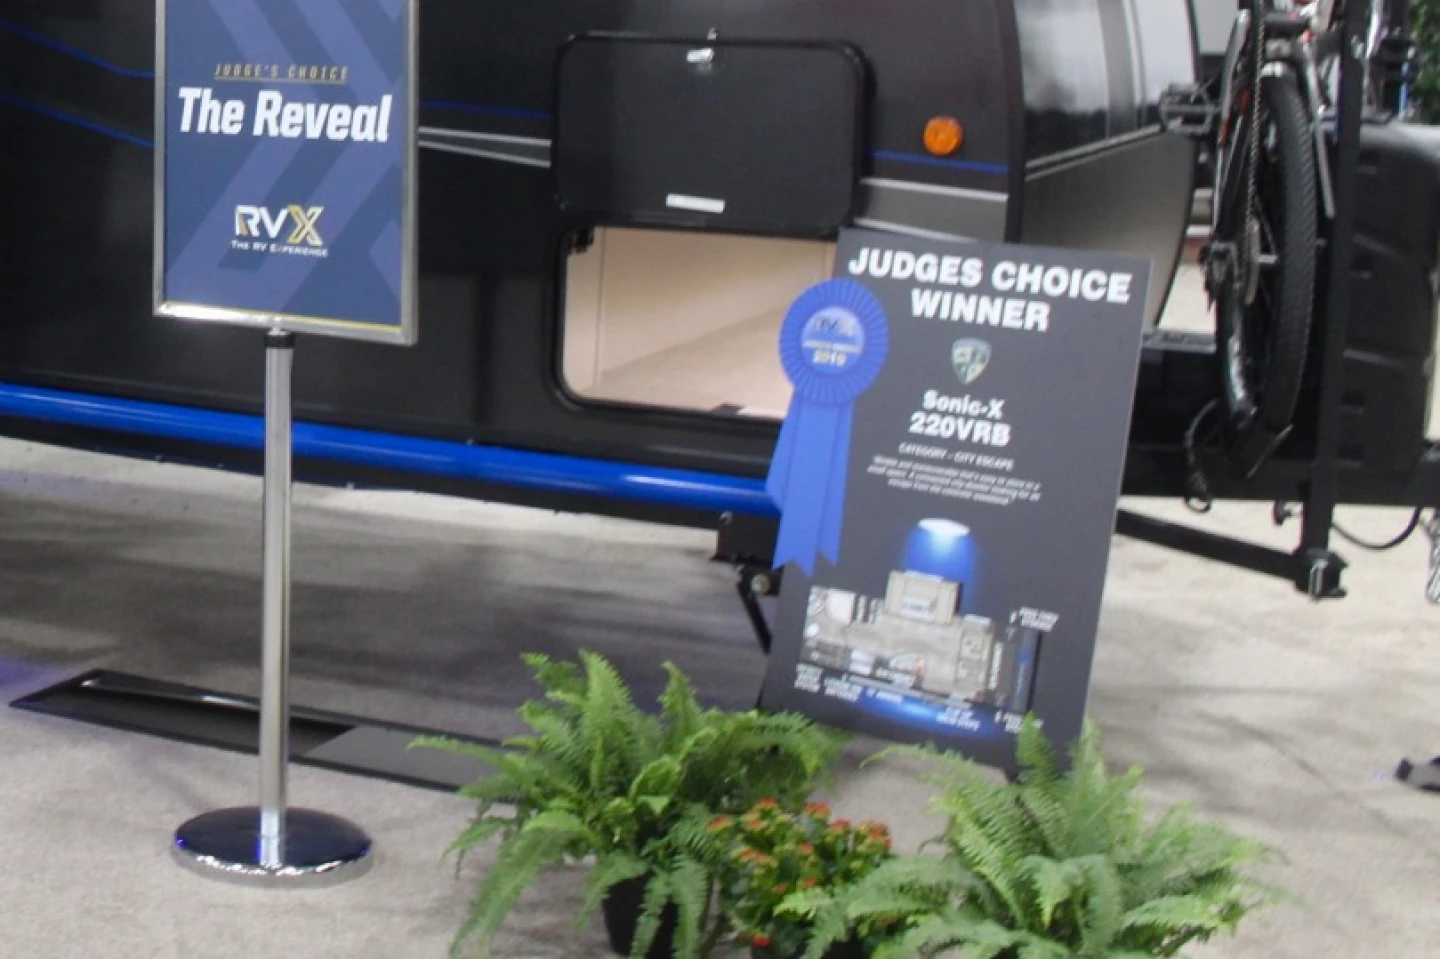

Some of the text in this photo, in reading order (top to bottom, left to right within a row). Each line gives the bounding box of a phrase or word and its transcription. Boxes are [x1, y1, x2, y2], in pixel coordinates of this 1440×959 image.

[215, 63, 349, 81] JUDGE'S CHOICE
[178, 87, 393, 144] The Reveal
[235, 204, 324, 247] RVX
[848, 247, 1133, 304] JUDGES CHOICE
[911, 287, 1051, 333] WINNER
[922, 389, 1006, 420] Sonic-X
[907, 410, 1012, 448] 220VRB
